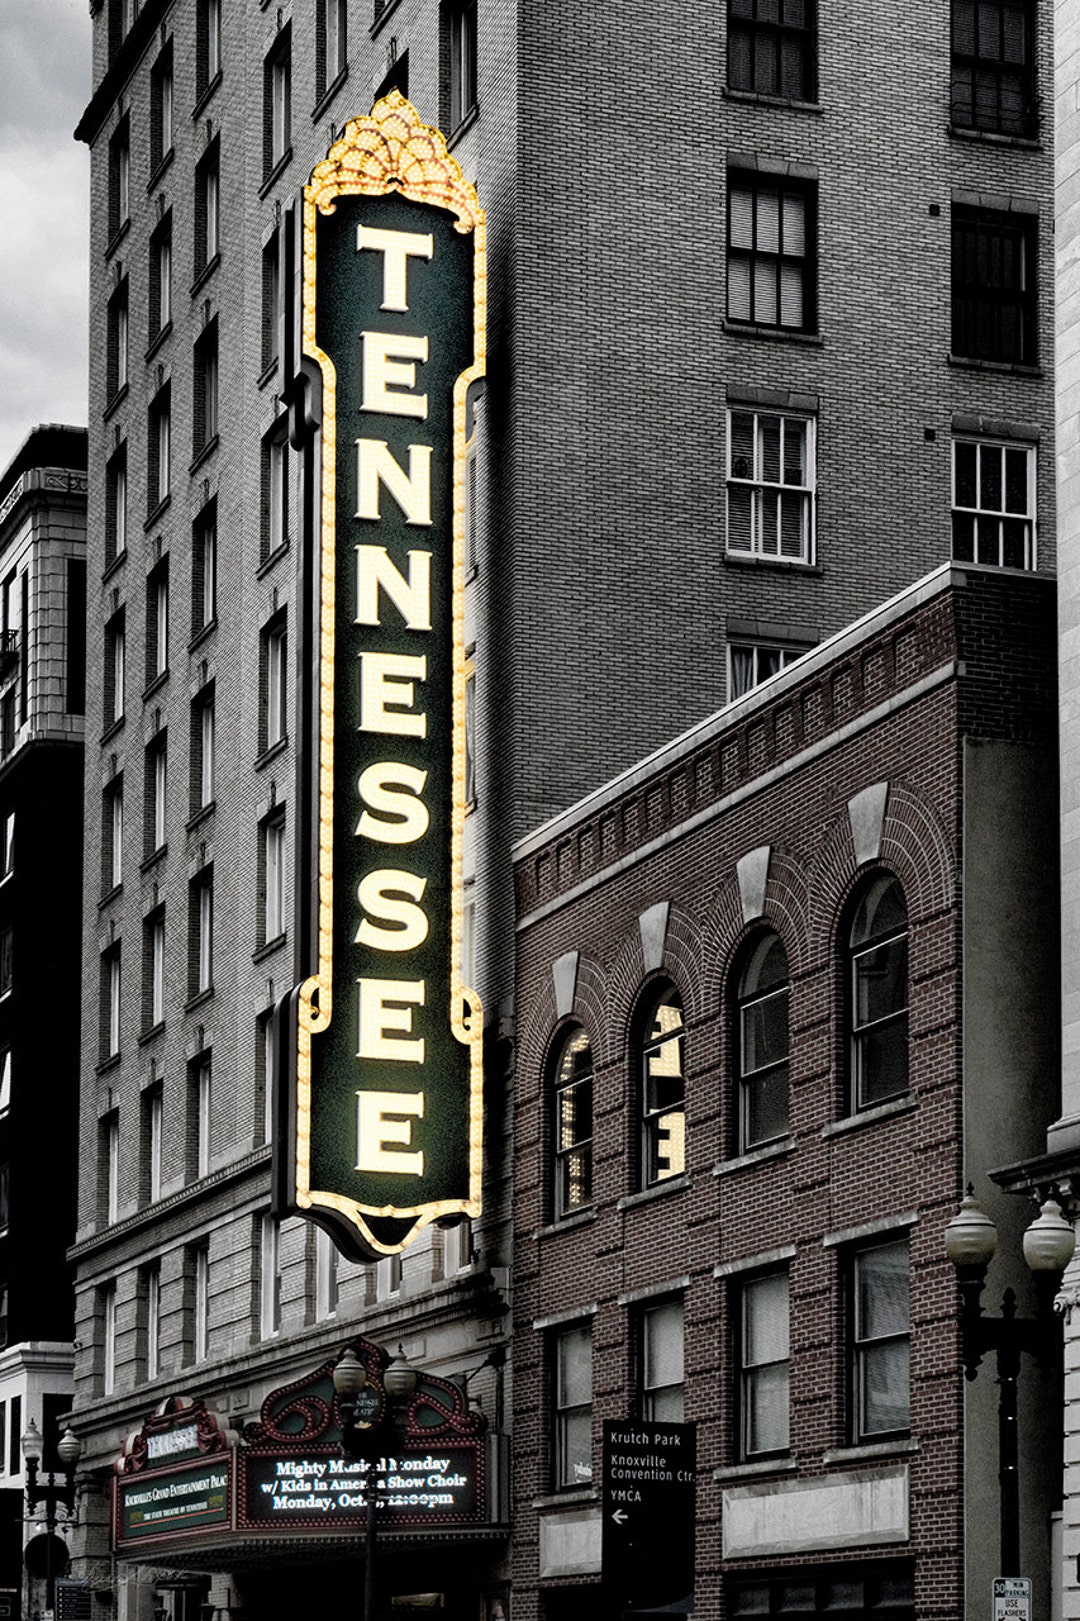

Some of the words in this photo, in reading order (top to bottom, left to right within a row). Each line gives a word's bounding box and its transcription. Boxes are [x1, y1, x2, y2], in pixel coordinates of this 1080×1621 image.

[354, 223, 434, 1177] TENNESSEE
[610, 1431, 649, 1445] Krutch
[654, 1433, 681, 1446] Park
[610, 1454, 667, 1468] Knoxville
[276, 1460, 327, 1478] Mighty
[610, 1467, 673, 1480] Convention
[677, 1470, 696, 1482] Ctr.
[260, 1480, 278, 1495] w/
[280, 1478, 312, 1492] Kids
[313, 1477, 328, 1490] in
[329, 1478, 387, 1490] Amera
[387, 1475, 425, 1489] Show
[427, 1473, 467, 1488] Choir
[272, 1493, 337, 1511] Monday,
[338, 1493, 368, 1507] Oct.
[610, 1489, 642, 1502] YMCA
[994, 1583, 1005, 1593] 30
[1004, 1599, 1018, 1608] USE
[997, 1609, 1026, 1617] FLASHERS
